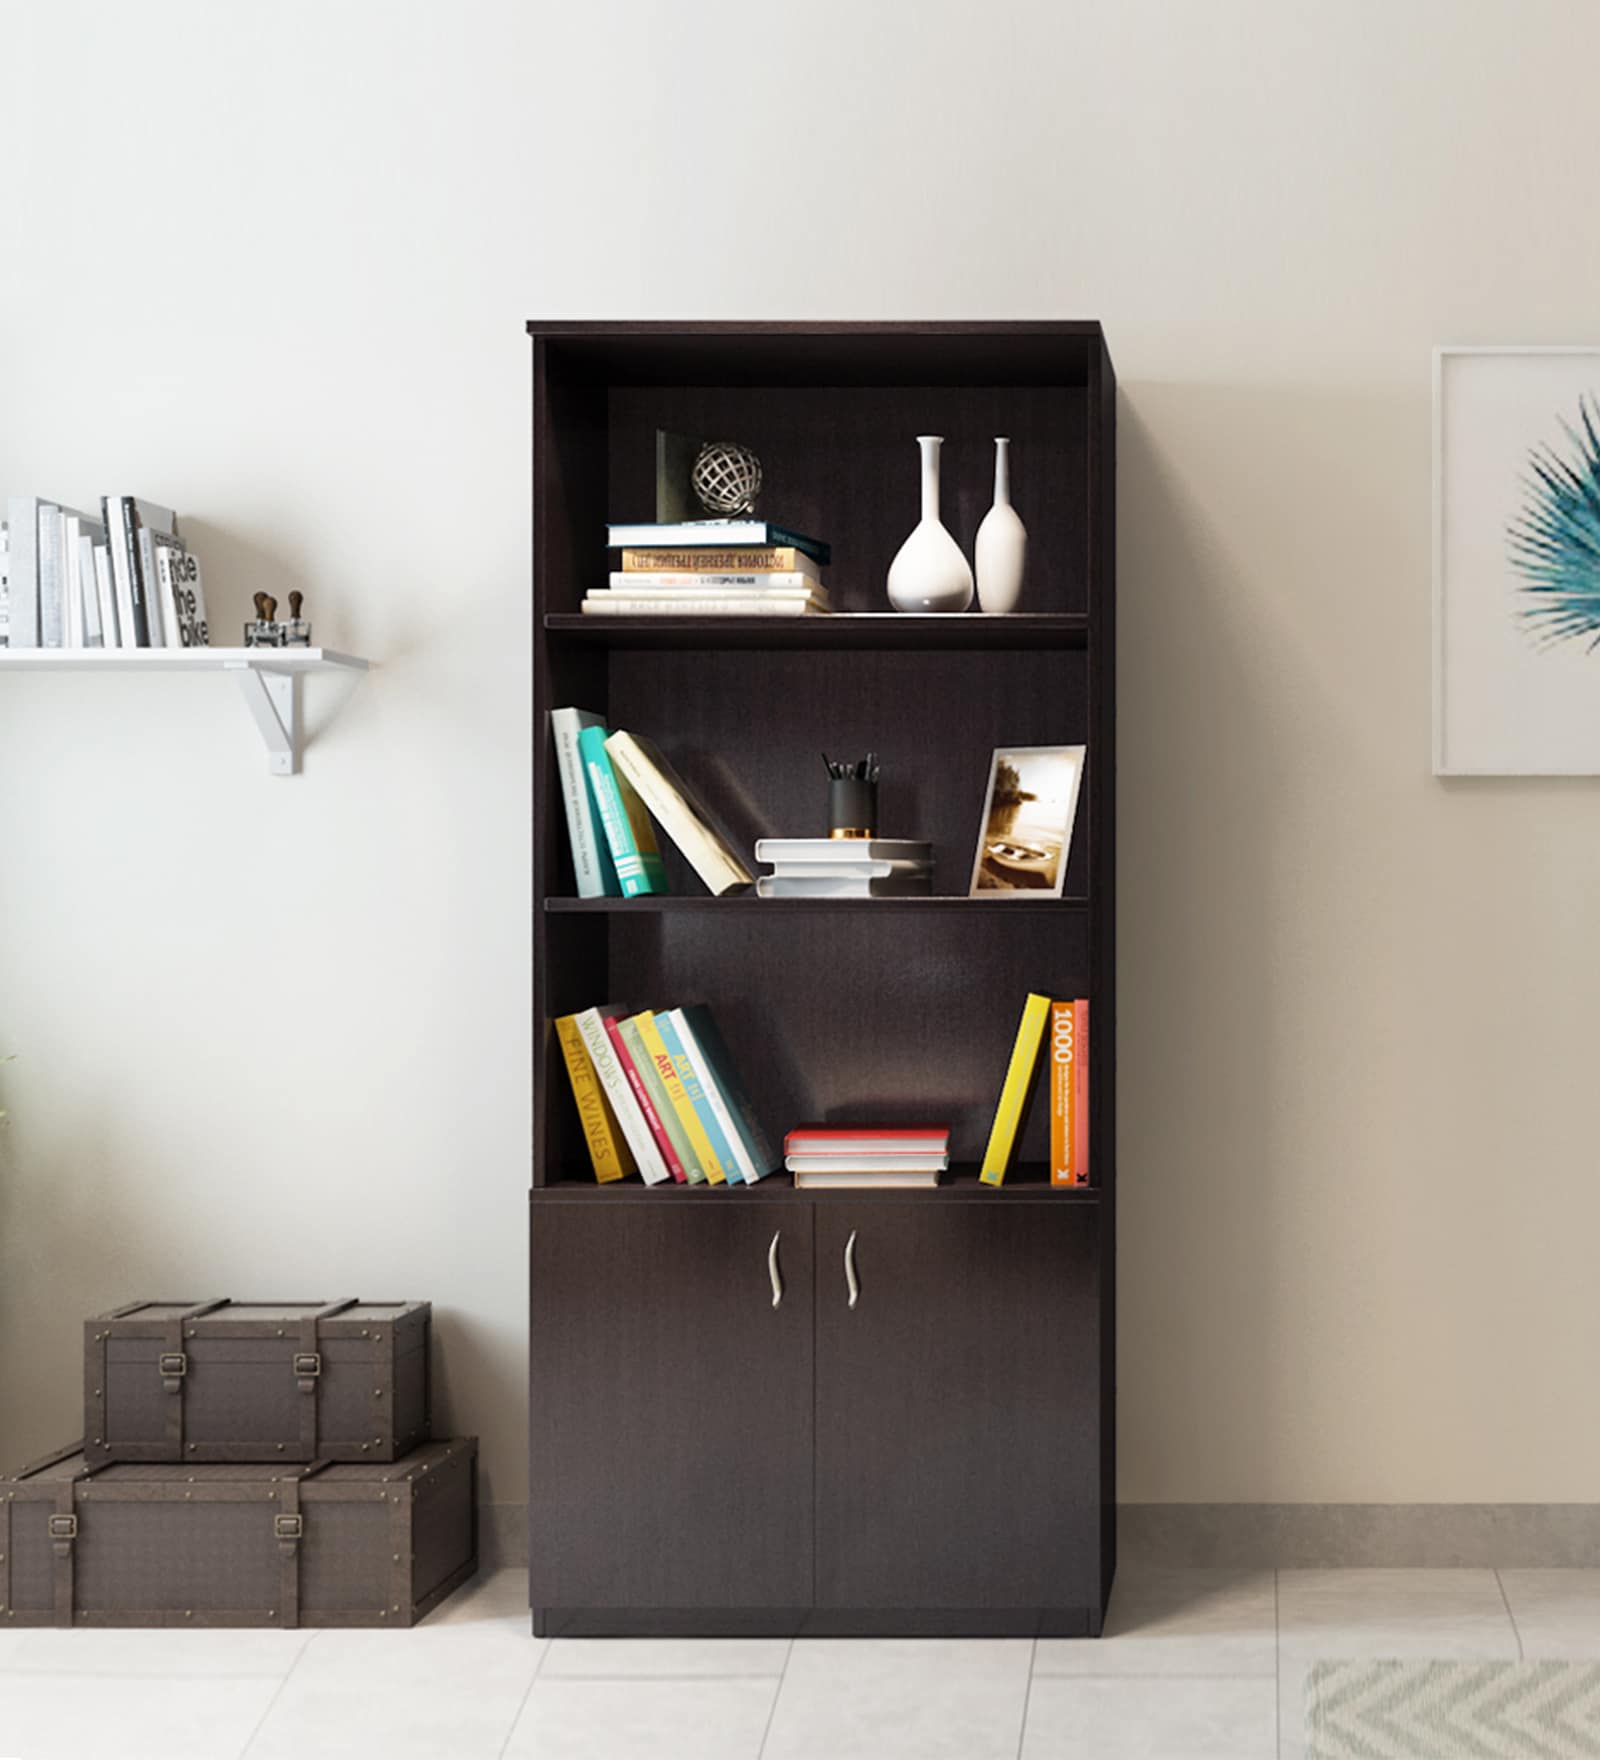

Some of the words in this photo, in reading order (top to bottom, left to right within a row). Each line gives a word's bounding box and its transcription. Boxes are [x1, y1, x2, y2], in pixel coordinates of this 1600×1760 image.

[582, 1014, 622, 1089] WINDOWS
[1054, 1010, 1073, 1063] 1000
[654, 1054, 678, 1080] ART
[672, 1055, 696, 1080] ART
[565, 1037, 591, 1083] FINE
[582, 1091, 611, 1160] WINES
